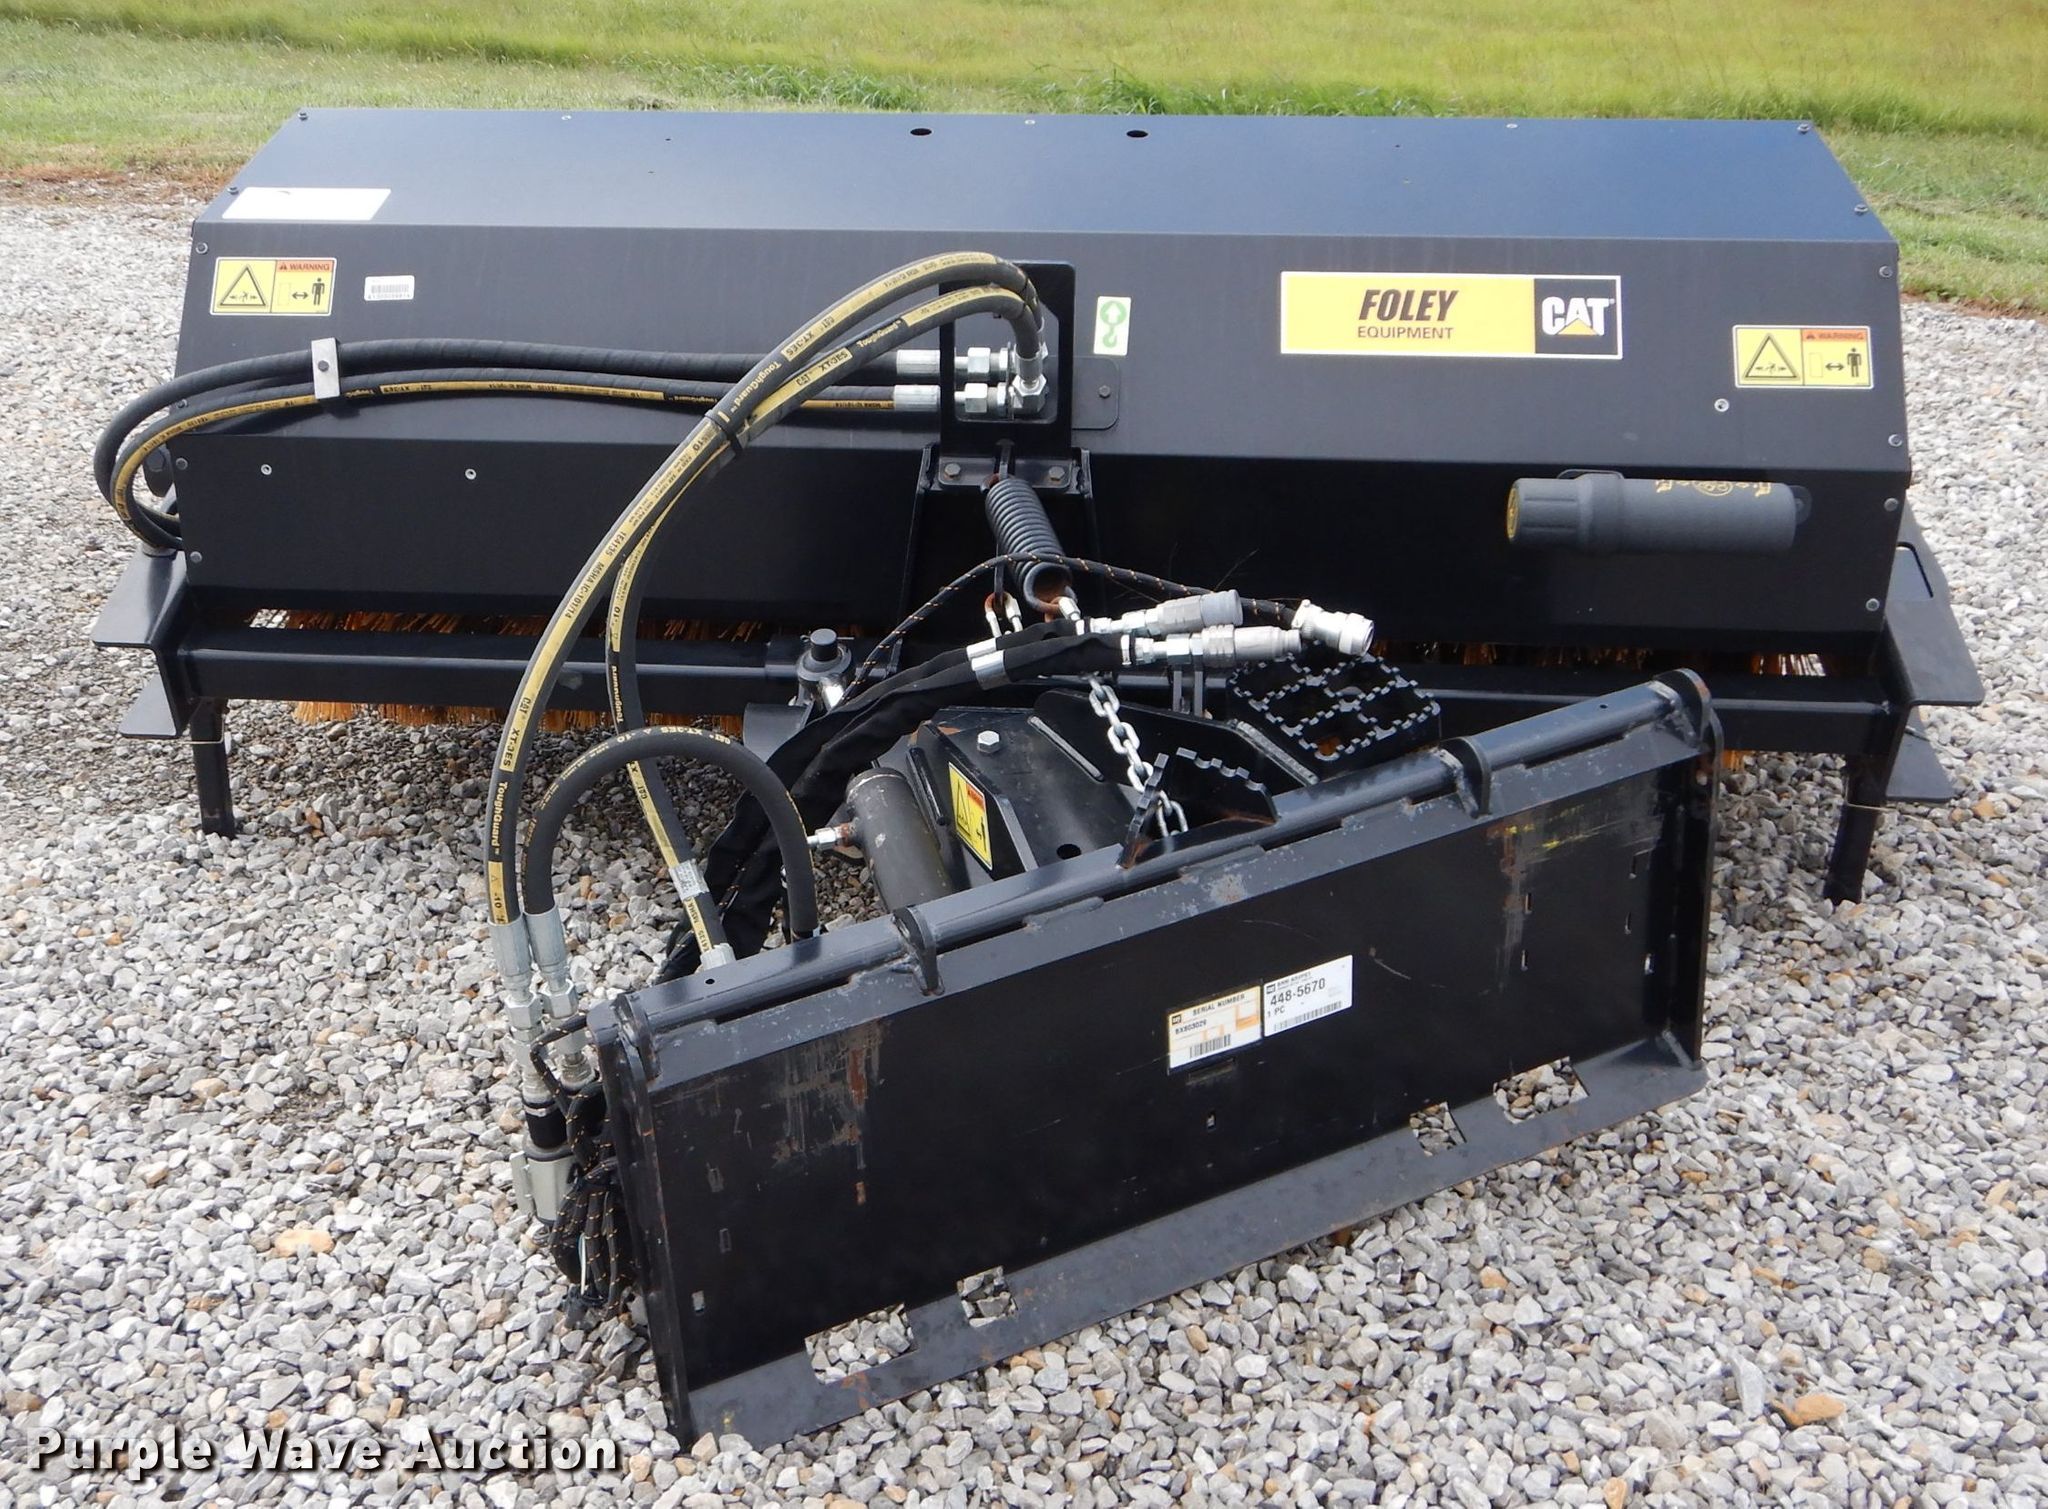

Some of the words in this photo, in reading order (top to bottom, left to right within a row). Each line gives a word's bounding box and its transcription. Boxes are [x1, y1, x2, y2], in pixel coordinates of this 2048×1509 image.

[289, 263, 330, 271] WARNING
[1358, 289, 1459, 322] FOLEY
[1541, 296, 1612, 336] CAT
[1357, 325, 1454, 340] EQUIPMENT
[1270, 977, 1326, 1007] 448-5670
[1193, 1002, 1216, 1016] SERIAL
[1217, 993, 1245, 1008] NUMBER
[1274, 1005, 1286, 1016] PC
